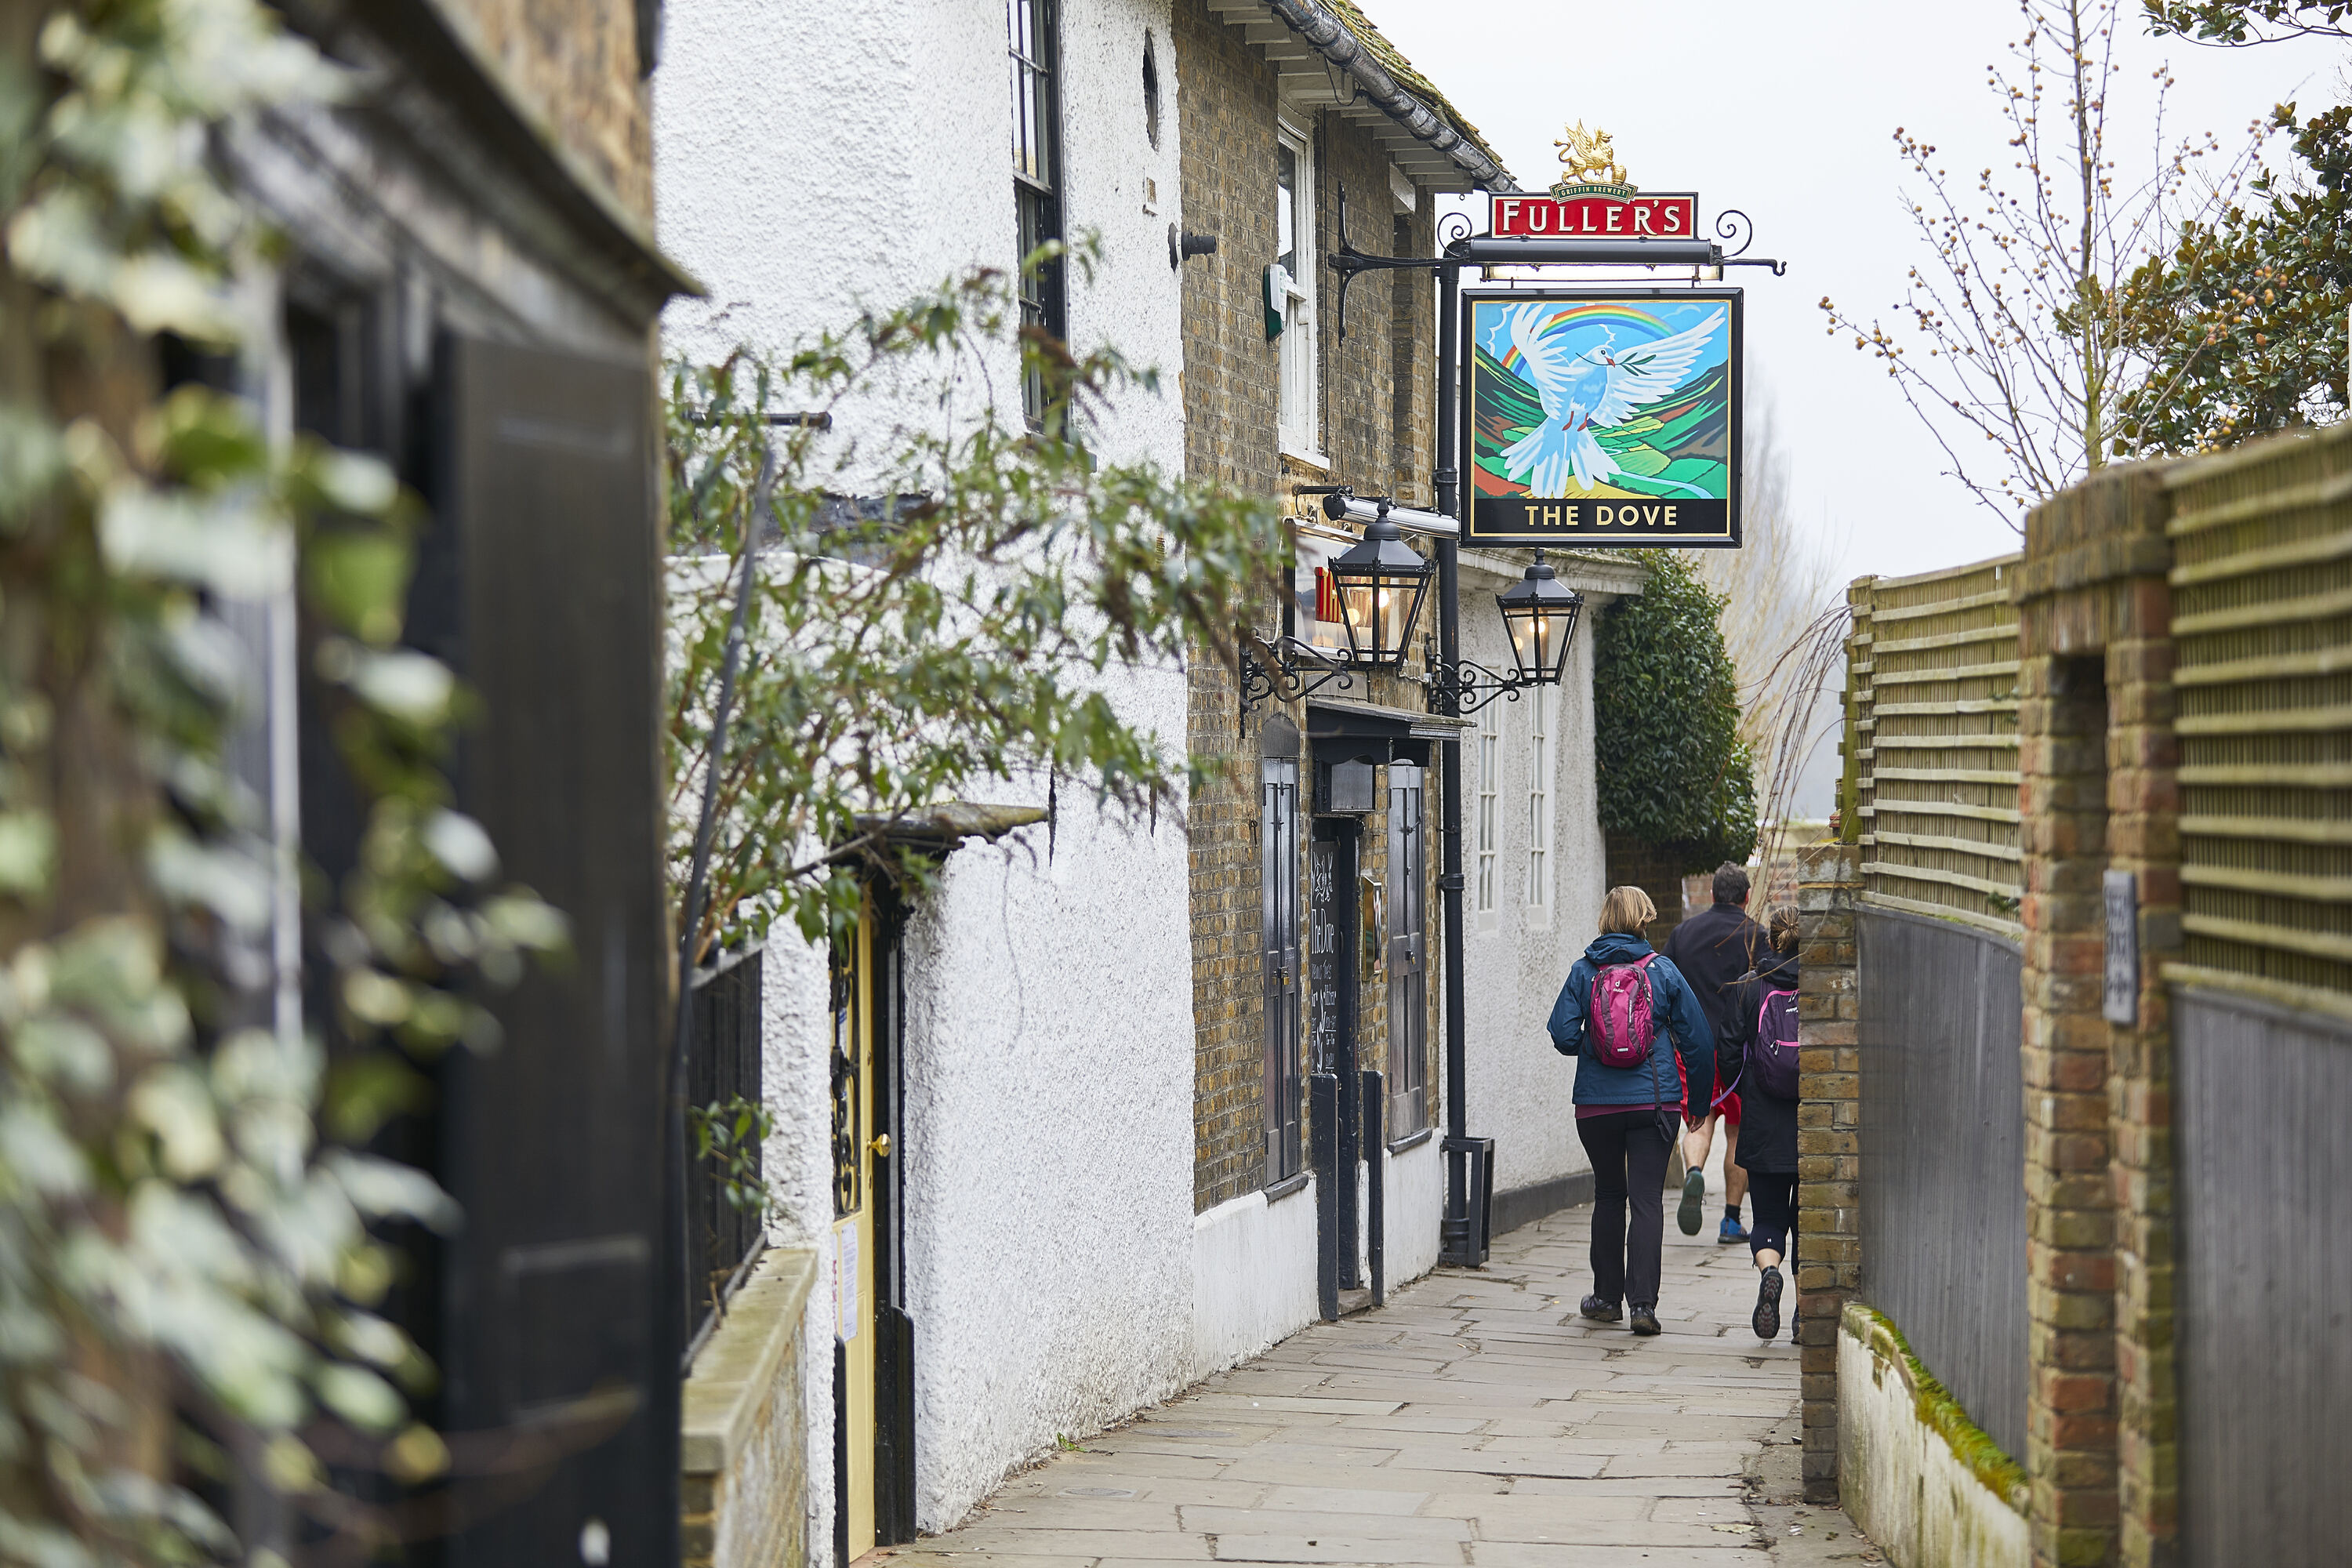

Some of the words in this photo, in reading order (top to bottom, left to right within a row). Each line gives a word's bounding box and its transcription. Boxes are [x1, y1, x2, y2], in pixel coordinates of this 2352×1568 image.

[1561, 187, 1590, 197] GRIFFIN
[1593, 186, 1627, 196] BREWERY
[1503, 200, 1681, 235] FULLER'S
[1525, 506, 1579, 526] THE
[1596, 505, 1677, 526] DOVE
